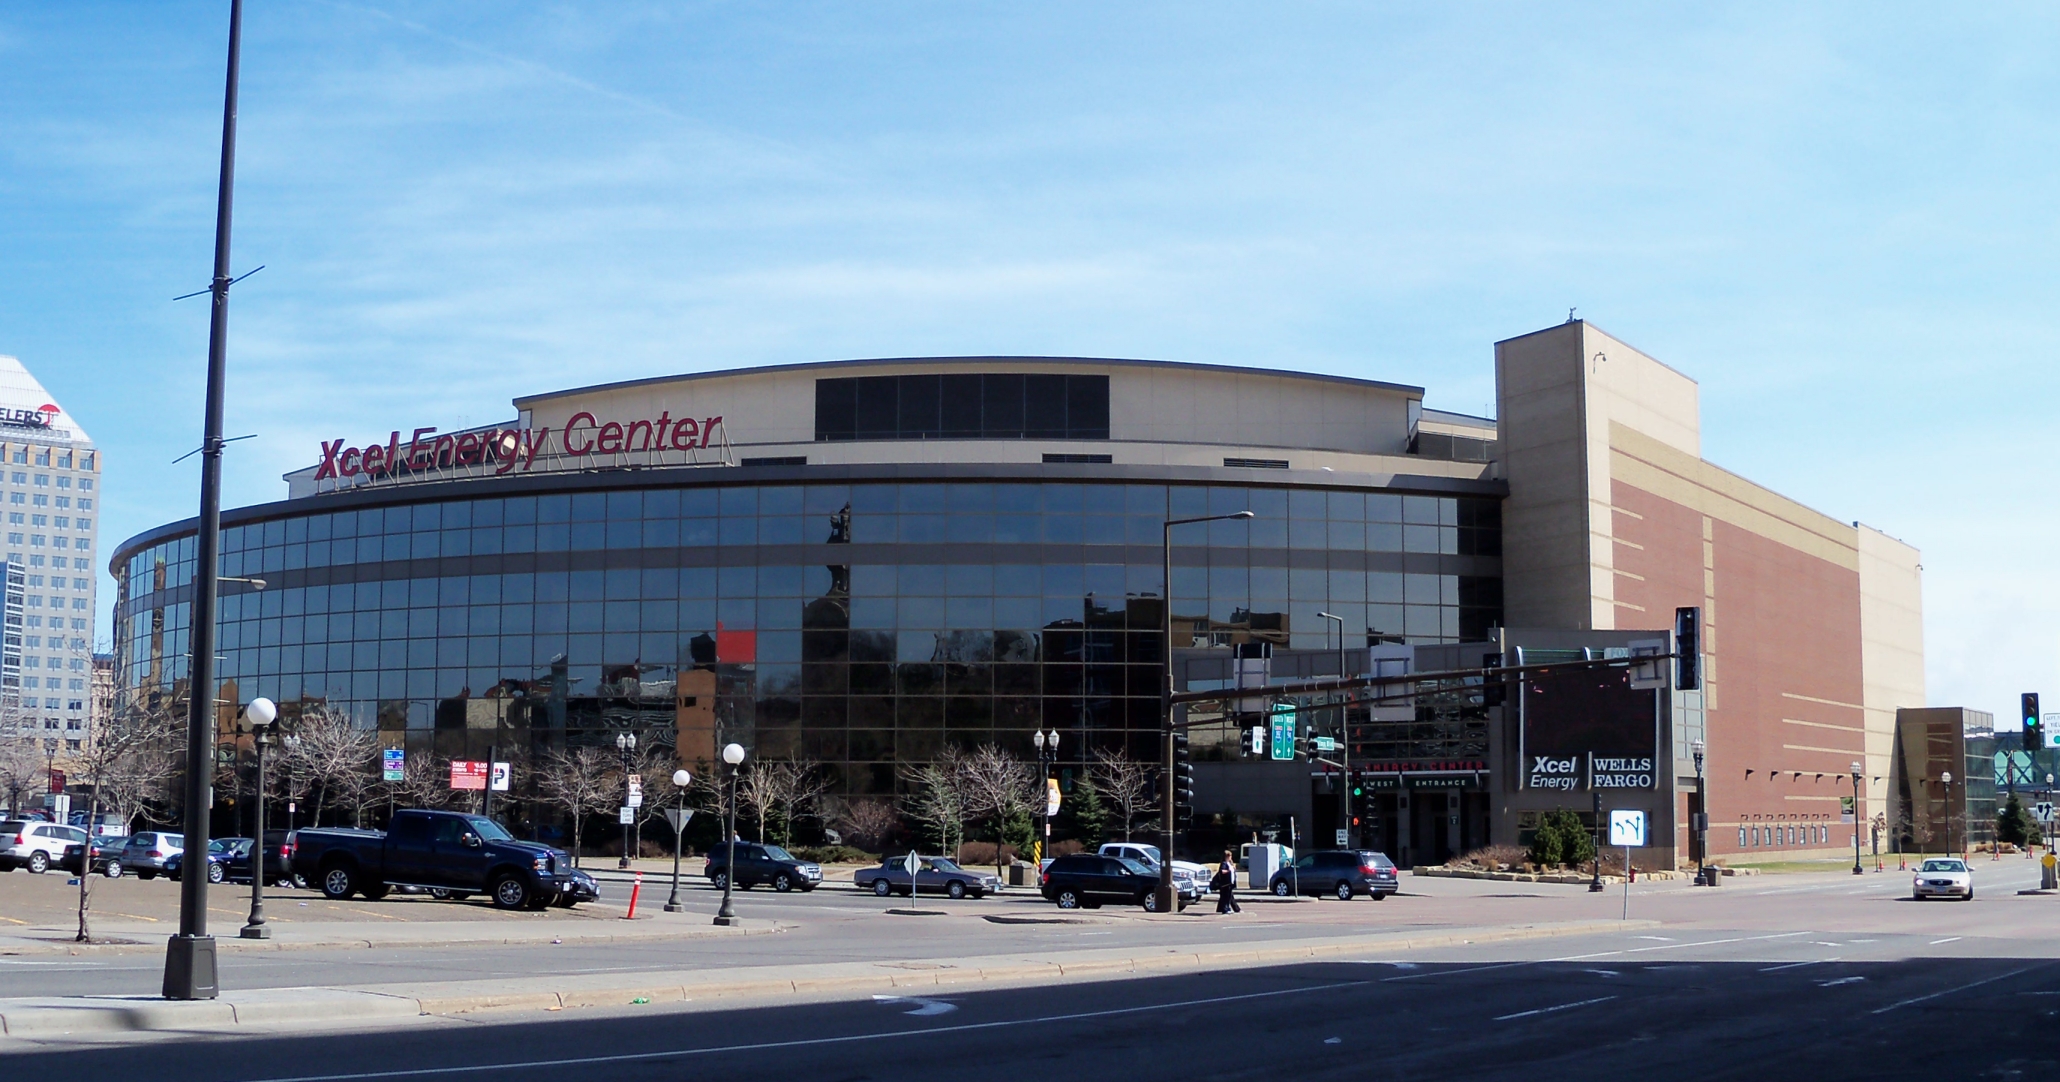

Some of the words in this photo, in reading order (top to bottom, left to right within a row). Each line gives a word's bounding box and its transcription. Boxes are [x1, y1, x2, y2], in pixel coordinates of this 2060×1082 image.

[314, 431, 400, 480] Xcel
[407, 427, 549, 474] Energy
[564, 411, 723, 456] Center
[1364, 762, 1419, 772] ENERGY
[1429, 760, 1484, 771] CENTER
[1531, 756, 1577, 773] Xcel
[1594, 758, 1651, 771] WELLS
[1415, 779, 1466, 787] ENTRANCE
[1530, 775, 1578, 790] Energy
[1594, 774, 1651, 788] FARGO
